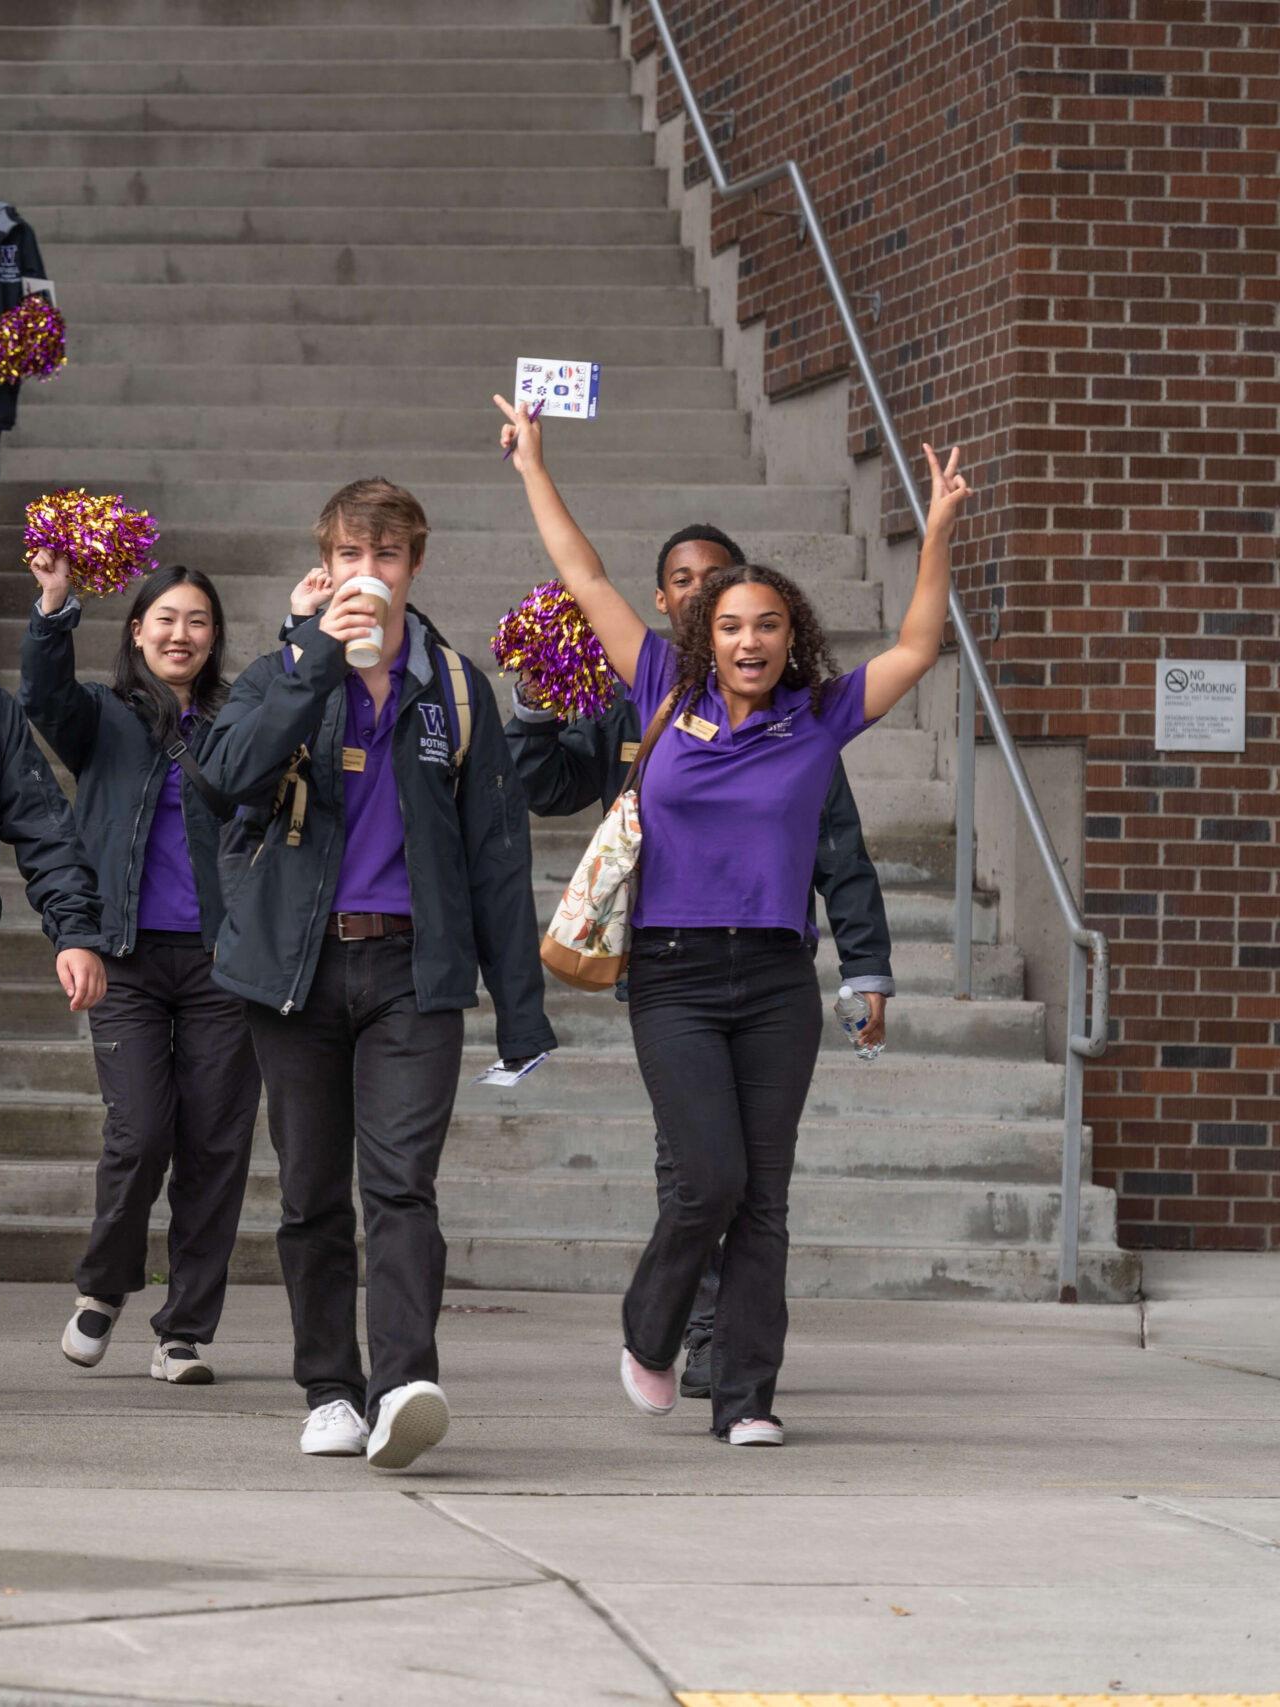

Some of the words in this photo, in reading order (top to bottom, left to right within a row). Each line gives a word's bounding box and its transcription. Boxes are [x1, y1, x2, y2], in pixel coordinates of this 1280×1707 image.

[1190, 670, 1205, 680] NO
[1190, 683, 1237, 694] SMOKING
[418, 703, 447, 738] W
